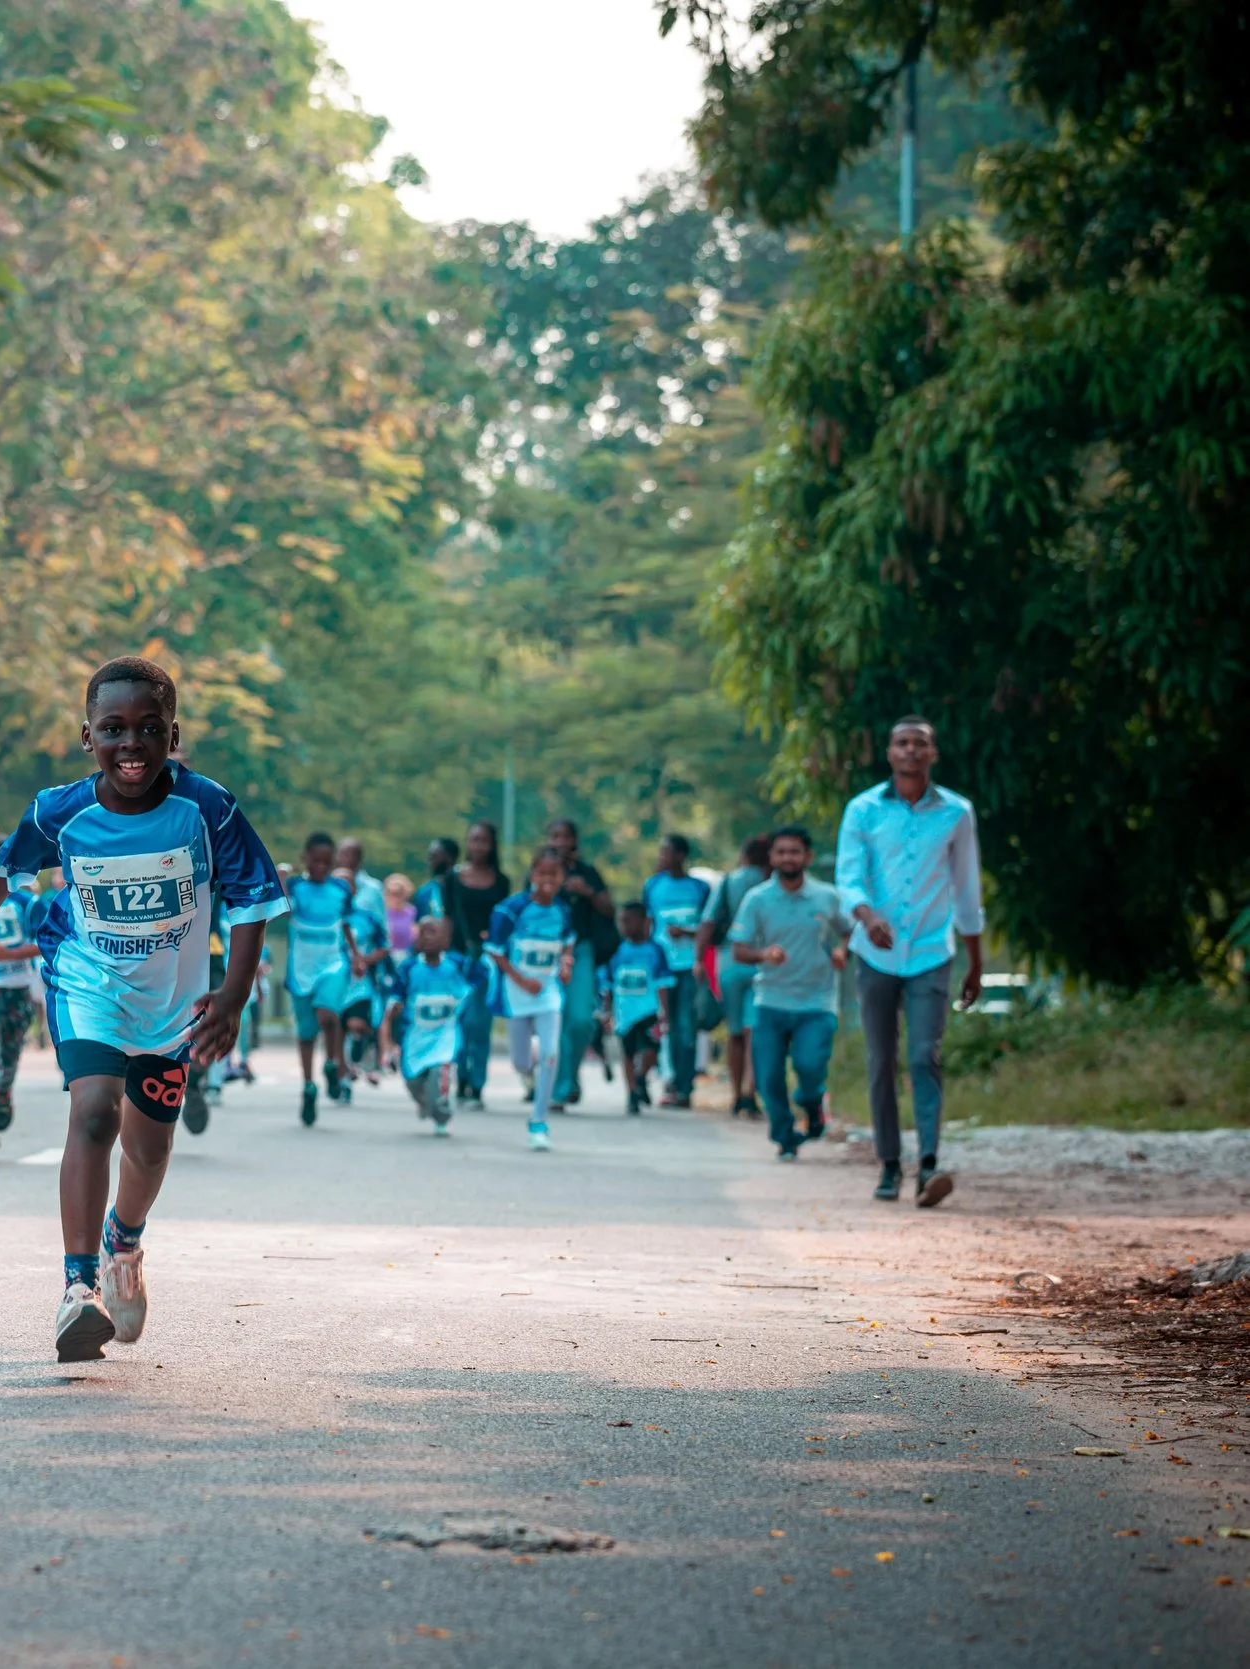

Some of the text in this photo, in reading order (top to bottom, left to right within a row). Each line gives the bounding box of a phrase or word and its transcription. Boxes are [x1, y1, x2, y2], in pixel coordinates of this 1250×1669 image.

[142, 874, 167, 882] Marathon
[107, 883, 165, 911] 122
[139, 913, 154, 921] VANI
[155, 911, 172, 919] OBED
[106, 923, 141, 931] RAWBANK
